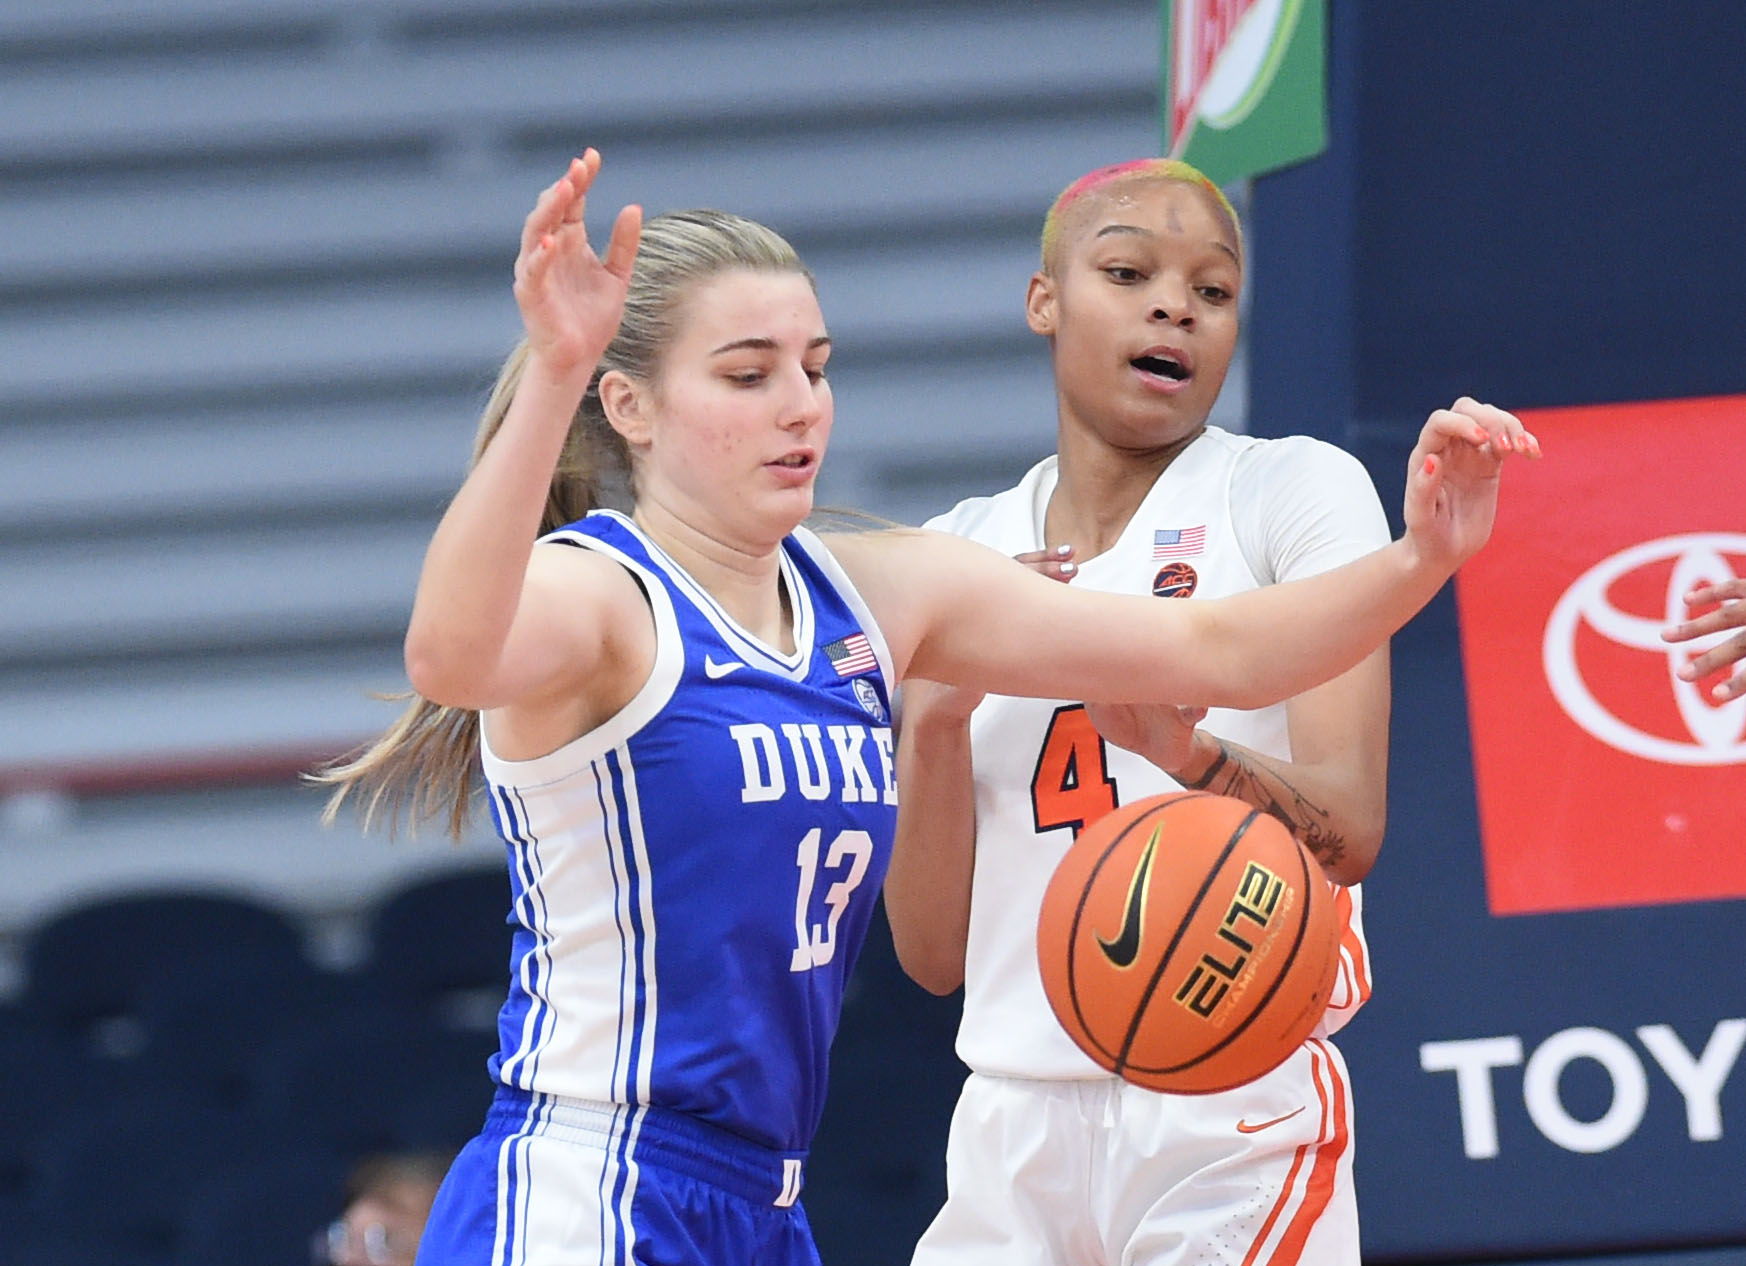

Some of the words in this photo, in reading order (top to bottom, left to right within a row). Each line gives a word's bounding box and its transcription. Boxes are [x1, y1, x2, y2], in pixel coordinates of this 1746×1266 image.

[729, 723, 898, 805] DUKE
[1031, 703, 1119, 844] 4
[790, 828, 873, 972] 13
[1173, 861, 1287, 1021] ELITE
[1419, 1017, 1746, 1160] TOY
